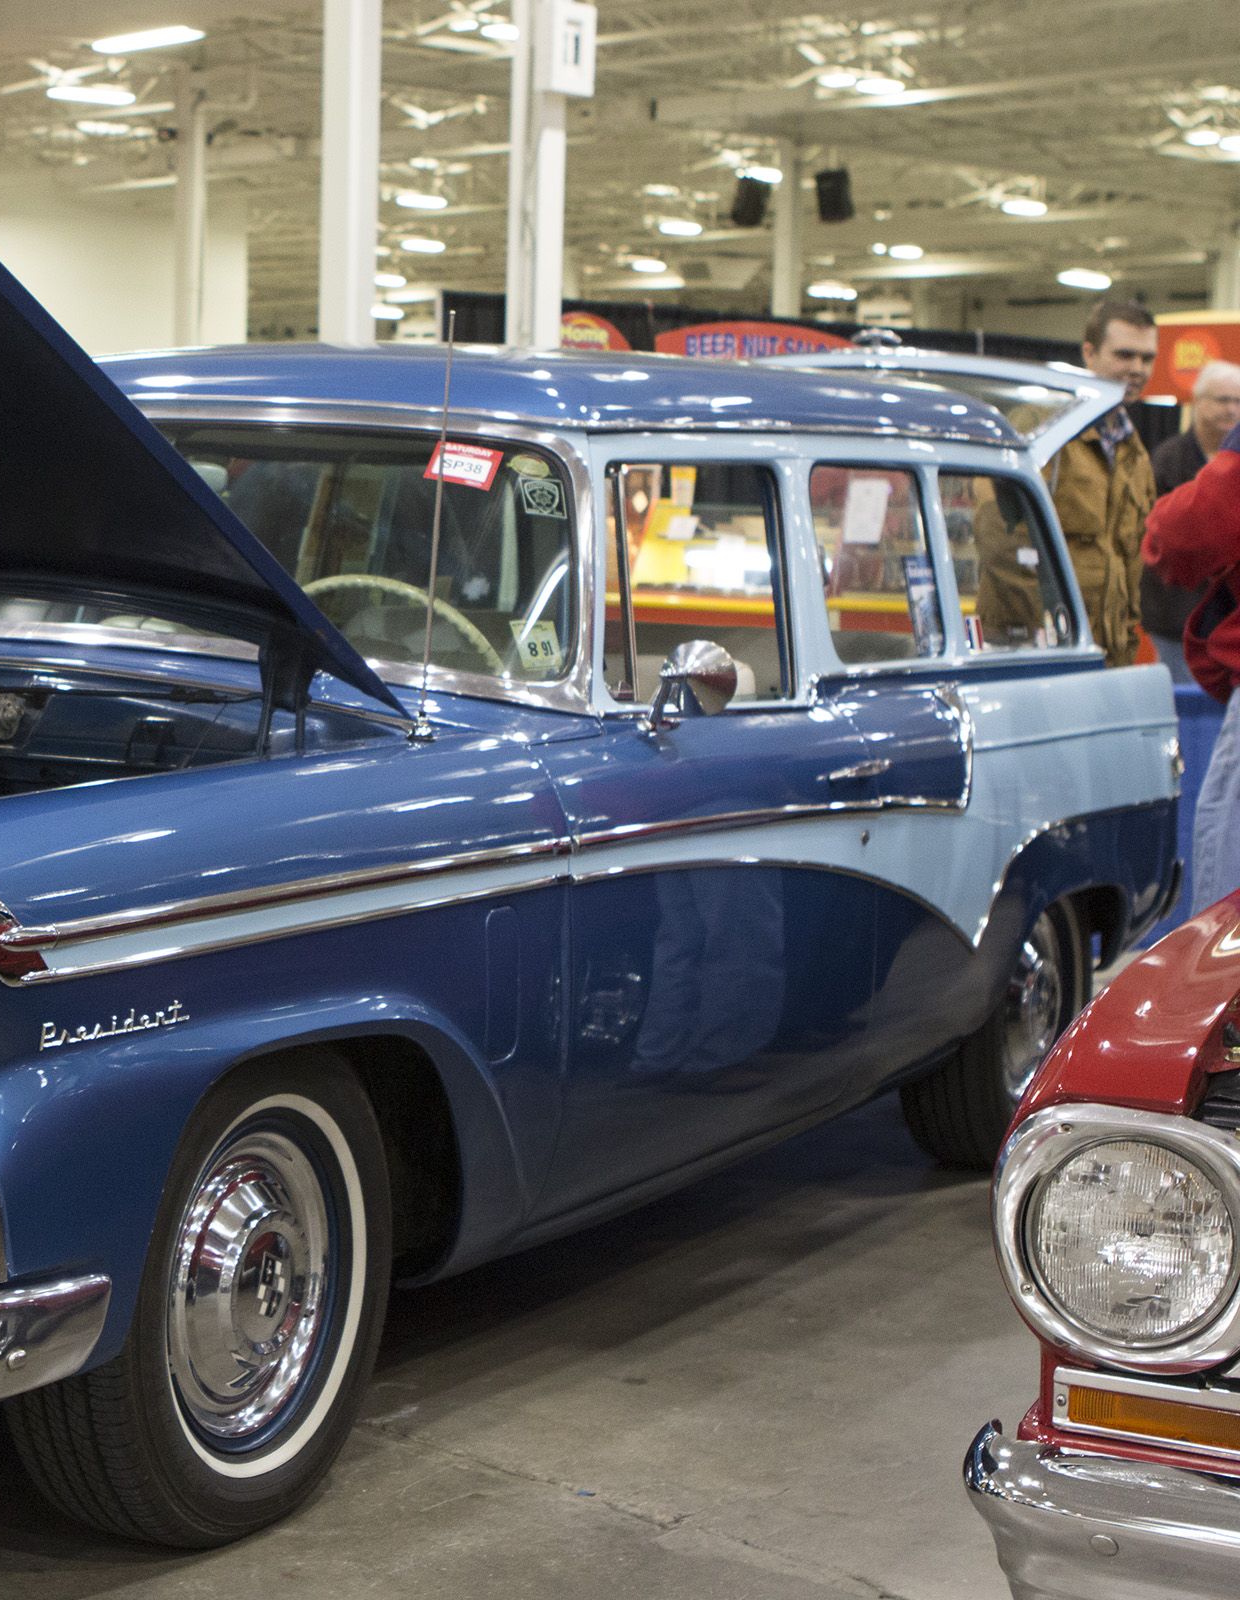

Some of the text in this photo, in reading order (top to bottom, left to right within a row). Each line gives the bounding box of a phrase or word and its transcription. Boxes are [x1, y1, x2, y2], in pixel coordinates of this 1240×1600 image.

[686, 333, 737, 357] BEER
[742, 335, 778, 357] NUT
[443, 458, 483, 474] SP38
[527, 640, 554, 657] 8 91
[39, 1000, 190, 1051] President
